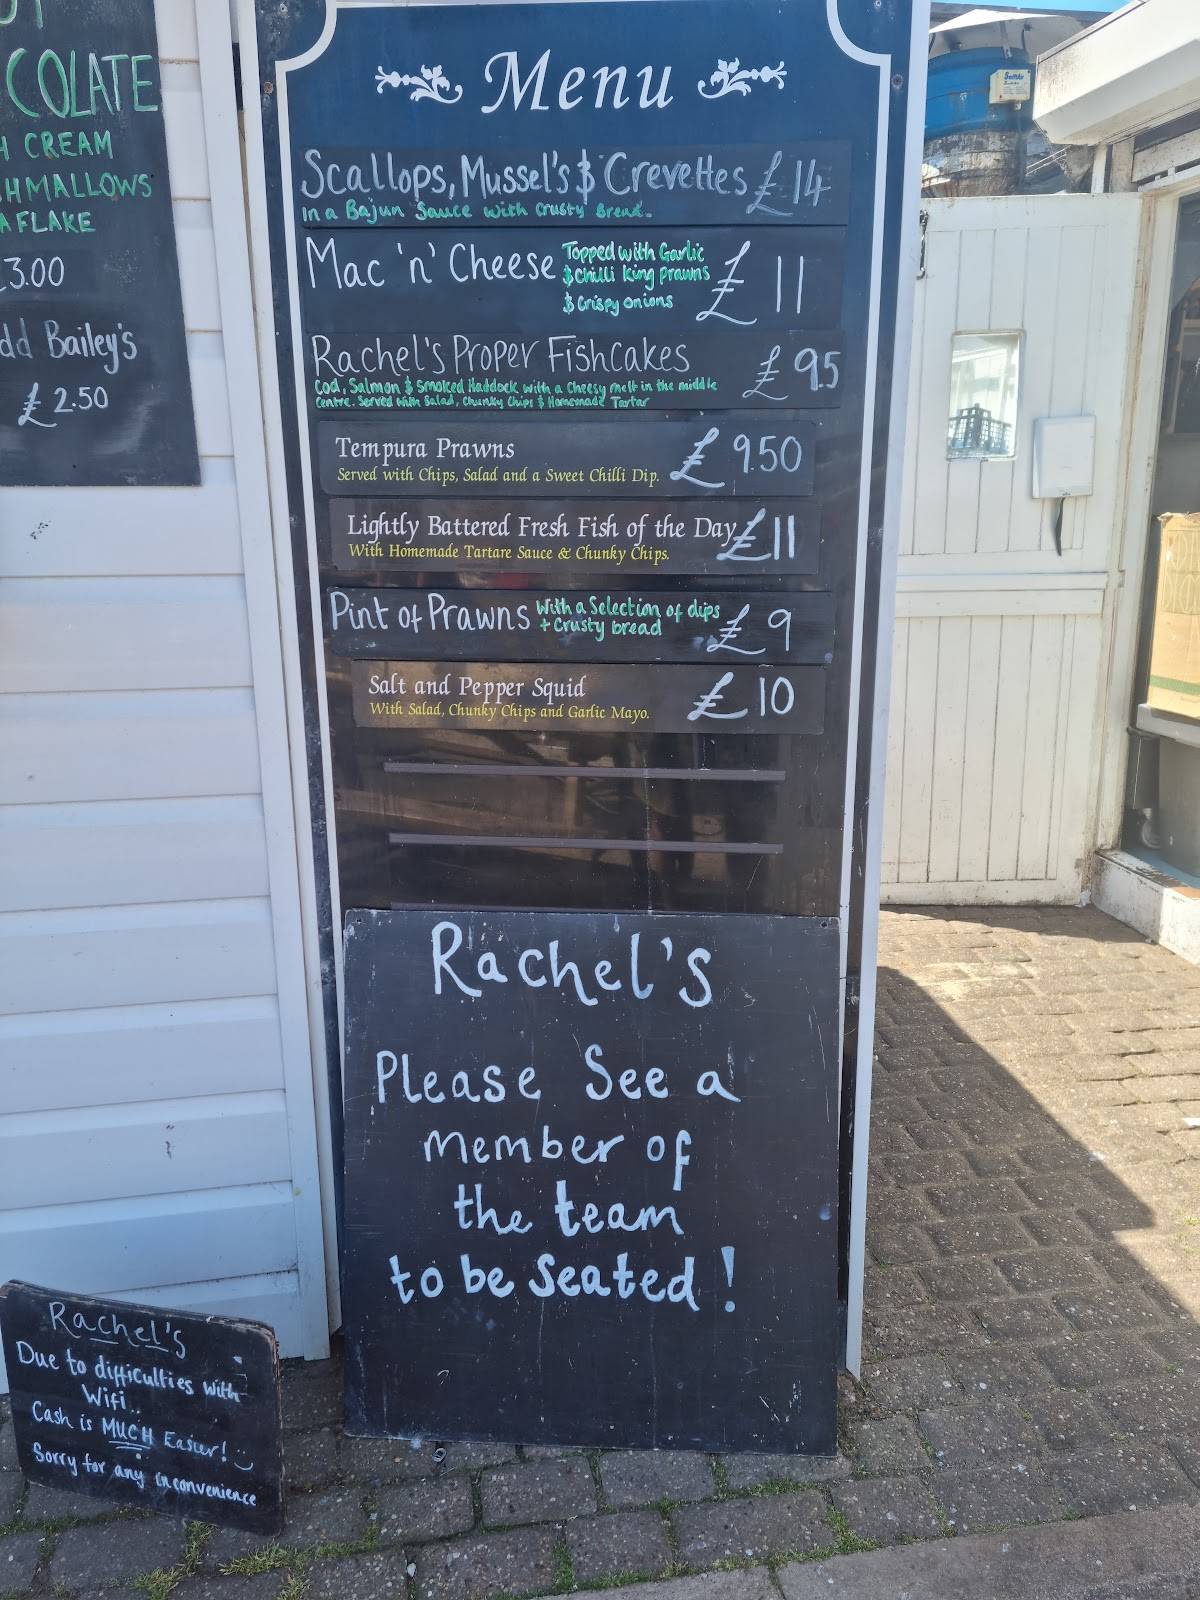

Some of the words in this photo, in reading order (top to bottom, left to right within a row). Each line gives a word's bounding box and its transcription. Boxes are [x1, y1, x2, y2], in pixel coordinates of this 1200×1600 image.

[4, 47, 158, 119] COLATE
[481, 49, 674, 114] Menu
[24, 130, 113, 160] CREAM
[0, 172, 152, 203] HMALLOWS
[301, 149, 456, 201] Scallops,
[459, 150, 570, 200] Mussel's
[603, 151, 748, 196] Crevettes
[325, 207, 338, 221] a
[415, 200, 473, 220] Sauce
[483, 201, 529, 219] with
[305, 236, 386, 289] Mac
[397, 241, 436, 284] 'n'
[449, 242, 556, 284] Cheese
[561, 240, 616, 264] Topped
[617, 240, 657, 263] with
[659, 239, 705, 263] Garlic
[0, 256, 65, 292] 3.00
[44, 318, 138, 375] Bailey's
[311, 333, 447, 377] Rachel's
[348, 375, 402, 394] Salmon
[467, 376, 520, 394] Haddock
[522, 379, 552, 395] with
[554, 384, 564, 394] a
[640, 380, 654, 392] in
[655, 378, 674, 393] the
[677, 376, 718, 392] middle
[357, 394, 394, 408] Served
[396, 396, 421, 408] with
[547, 394, 606, 409] Homemade
[609, 395, 650, 409] Tartar
[335, 437, 429, 467] Tempura
[436, 437, 516, 459] Prawns
[337, 466, 379, 482] Served
[383, 467, 414, 482] with
[418, 466, 459, 486] Chips,
[463, 467, 499, 482] Salad
[503, 467, 528, 482] and
[532, 472, 541, 482] a
[545, 468, 585, 482] Sweet
[589, 467, 627, 482] Chilli
[632, 468, 660, 487] Dip.
[347, 512, 420, 545] Lightly
[428, 513, 512, 538] Battered
[518, 513, 571, 538] Fresh
[578, 513, 620, 538] Fish
[626, 513, 650, 547] of
[654, 514, 686, 538] the
[693, 517, 737, 547] Day
[348, 543, 384, 558] With
[389, 543, 460, 559] Homemade
[464, 545, 513, 560] Tartare
[517, 545, 553, 560] Sauce
[557, 547, 571, 560] &
[575, 544, 627, 565] Chunky
[630, 544, 670, 566] Chips.
[330, 591, 389, 631] Pint
[398, 603, 423, 633] of
[427, 592, 531, 631] Prawns
[575, 601, 587, 615] a
[588, 595, 661, 618] Selection
[665, 602, 684, 624] of
[687, 598, 721, 623] dips
[368, 672, 407, 695] Salt
[414, 673, 451, 696] and
[458, 676, 525, 705] Pepper
[531, 675, 587, 705] Squid
[369, 699, 402, 716] With
[408, 700, 445, 717] Salad,
[449, 701, 497, 722] Chunky
[501, 703, 536, 722] Chips
[540, 703, 564, 718] and
[568, 704, 607, 719] Garlic
[611, 705, 650, 724] Mayo.
[431, 920, 714, 1008] Rachel's
[376, 1049, 542, 1104] Please
[584, 1043, 670, 1101] See
[696, 1070, 742, 1103] a
[645, 1128, 693, 1192] of
[453, 1183, 533, 1236] the
[554, 1179, 685, 1238] team
[388, 1253, 445, 1306] to
[460, 1253, 515, 1297] be
[49, 1301, 187, 1360] Rachel's
[16, 1340, 60, 1371] Due
[66, 1347, 88, 1377] to
[95, 1355, 196, 1397] difficulties
[32, 1400, 75, 1430] Cash
[80, 1413, 93, 1432] is
[102, 1416, 155, 1447] MUCH
[33, 1441, 78, 1477] Sorry
[82, 1451, 106, 1475] for
[114, 1464, 146, 1490] any
